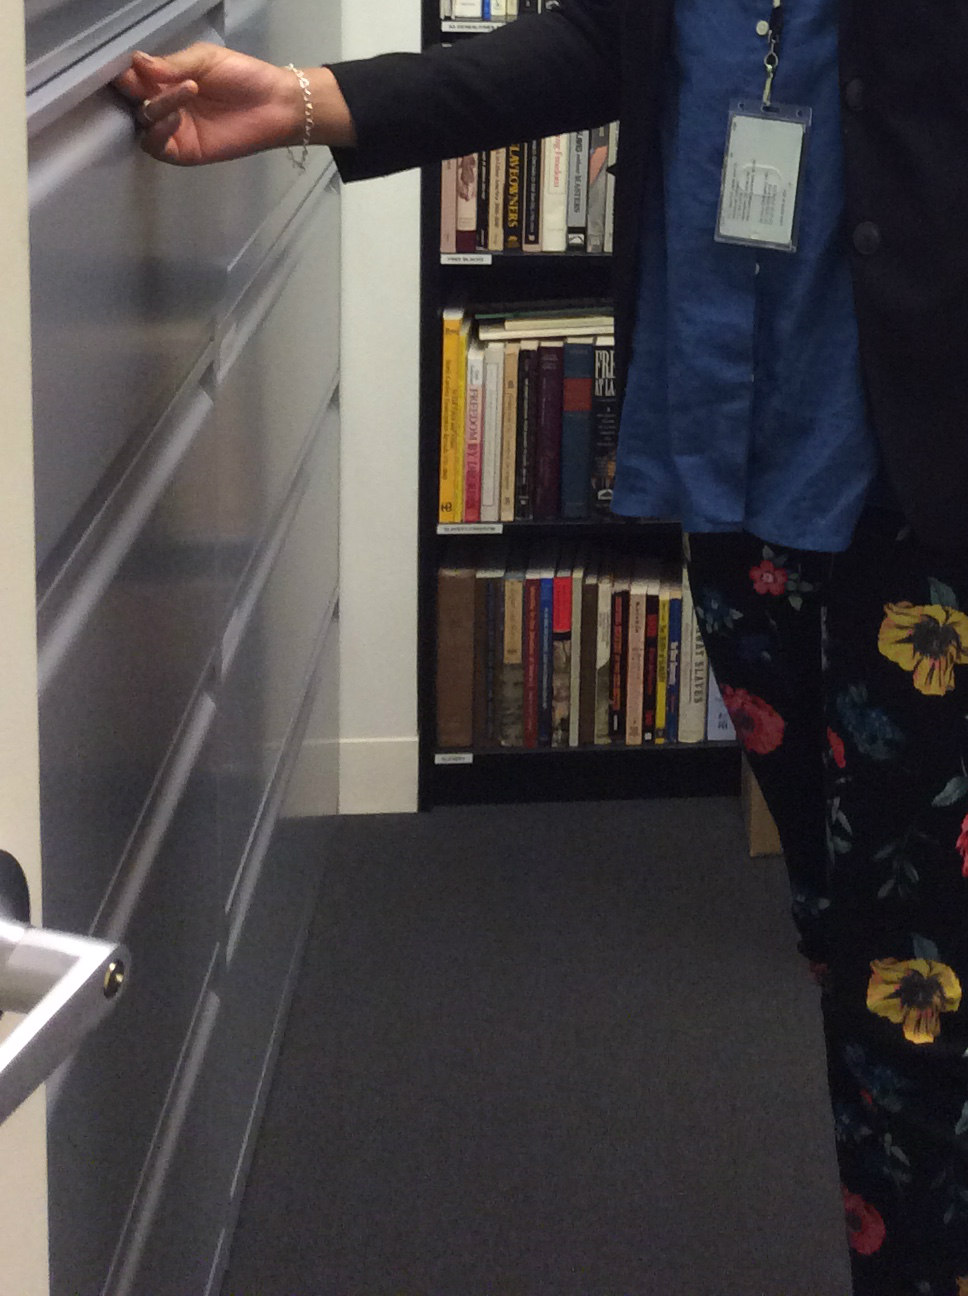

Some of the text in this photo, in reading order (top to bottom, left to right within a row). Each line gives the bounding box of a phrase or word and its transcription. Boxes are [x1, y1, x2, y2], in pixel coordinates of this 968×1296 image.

[508, 144, 520, 228] LAVEOWNERS
[468, 388, 479, 440] FREEDOM
[694, 661, 705, 704] SLAVES
